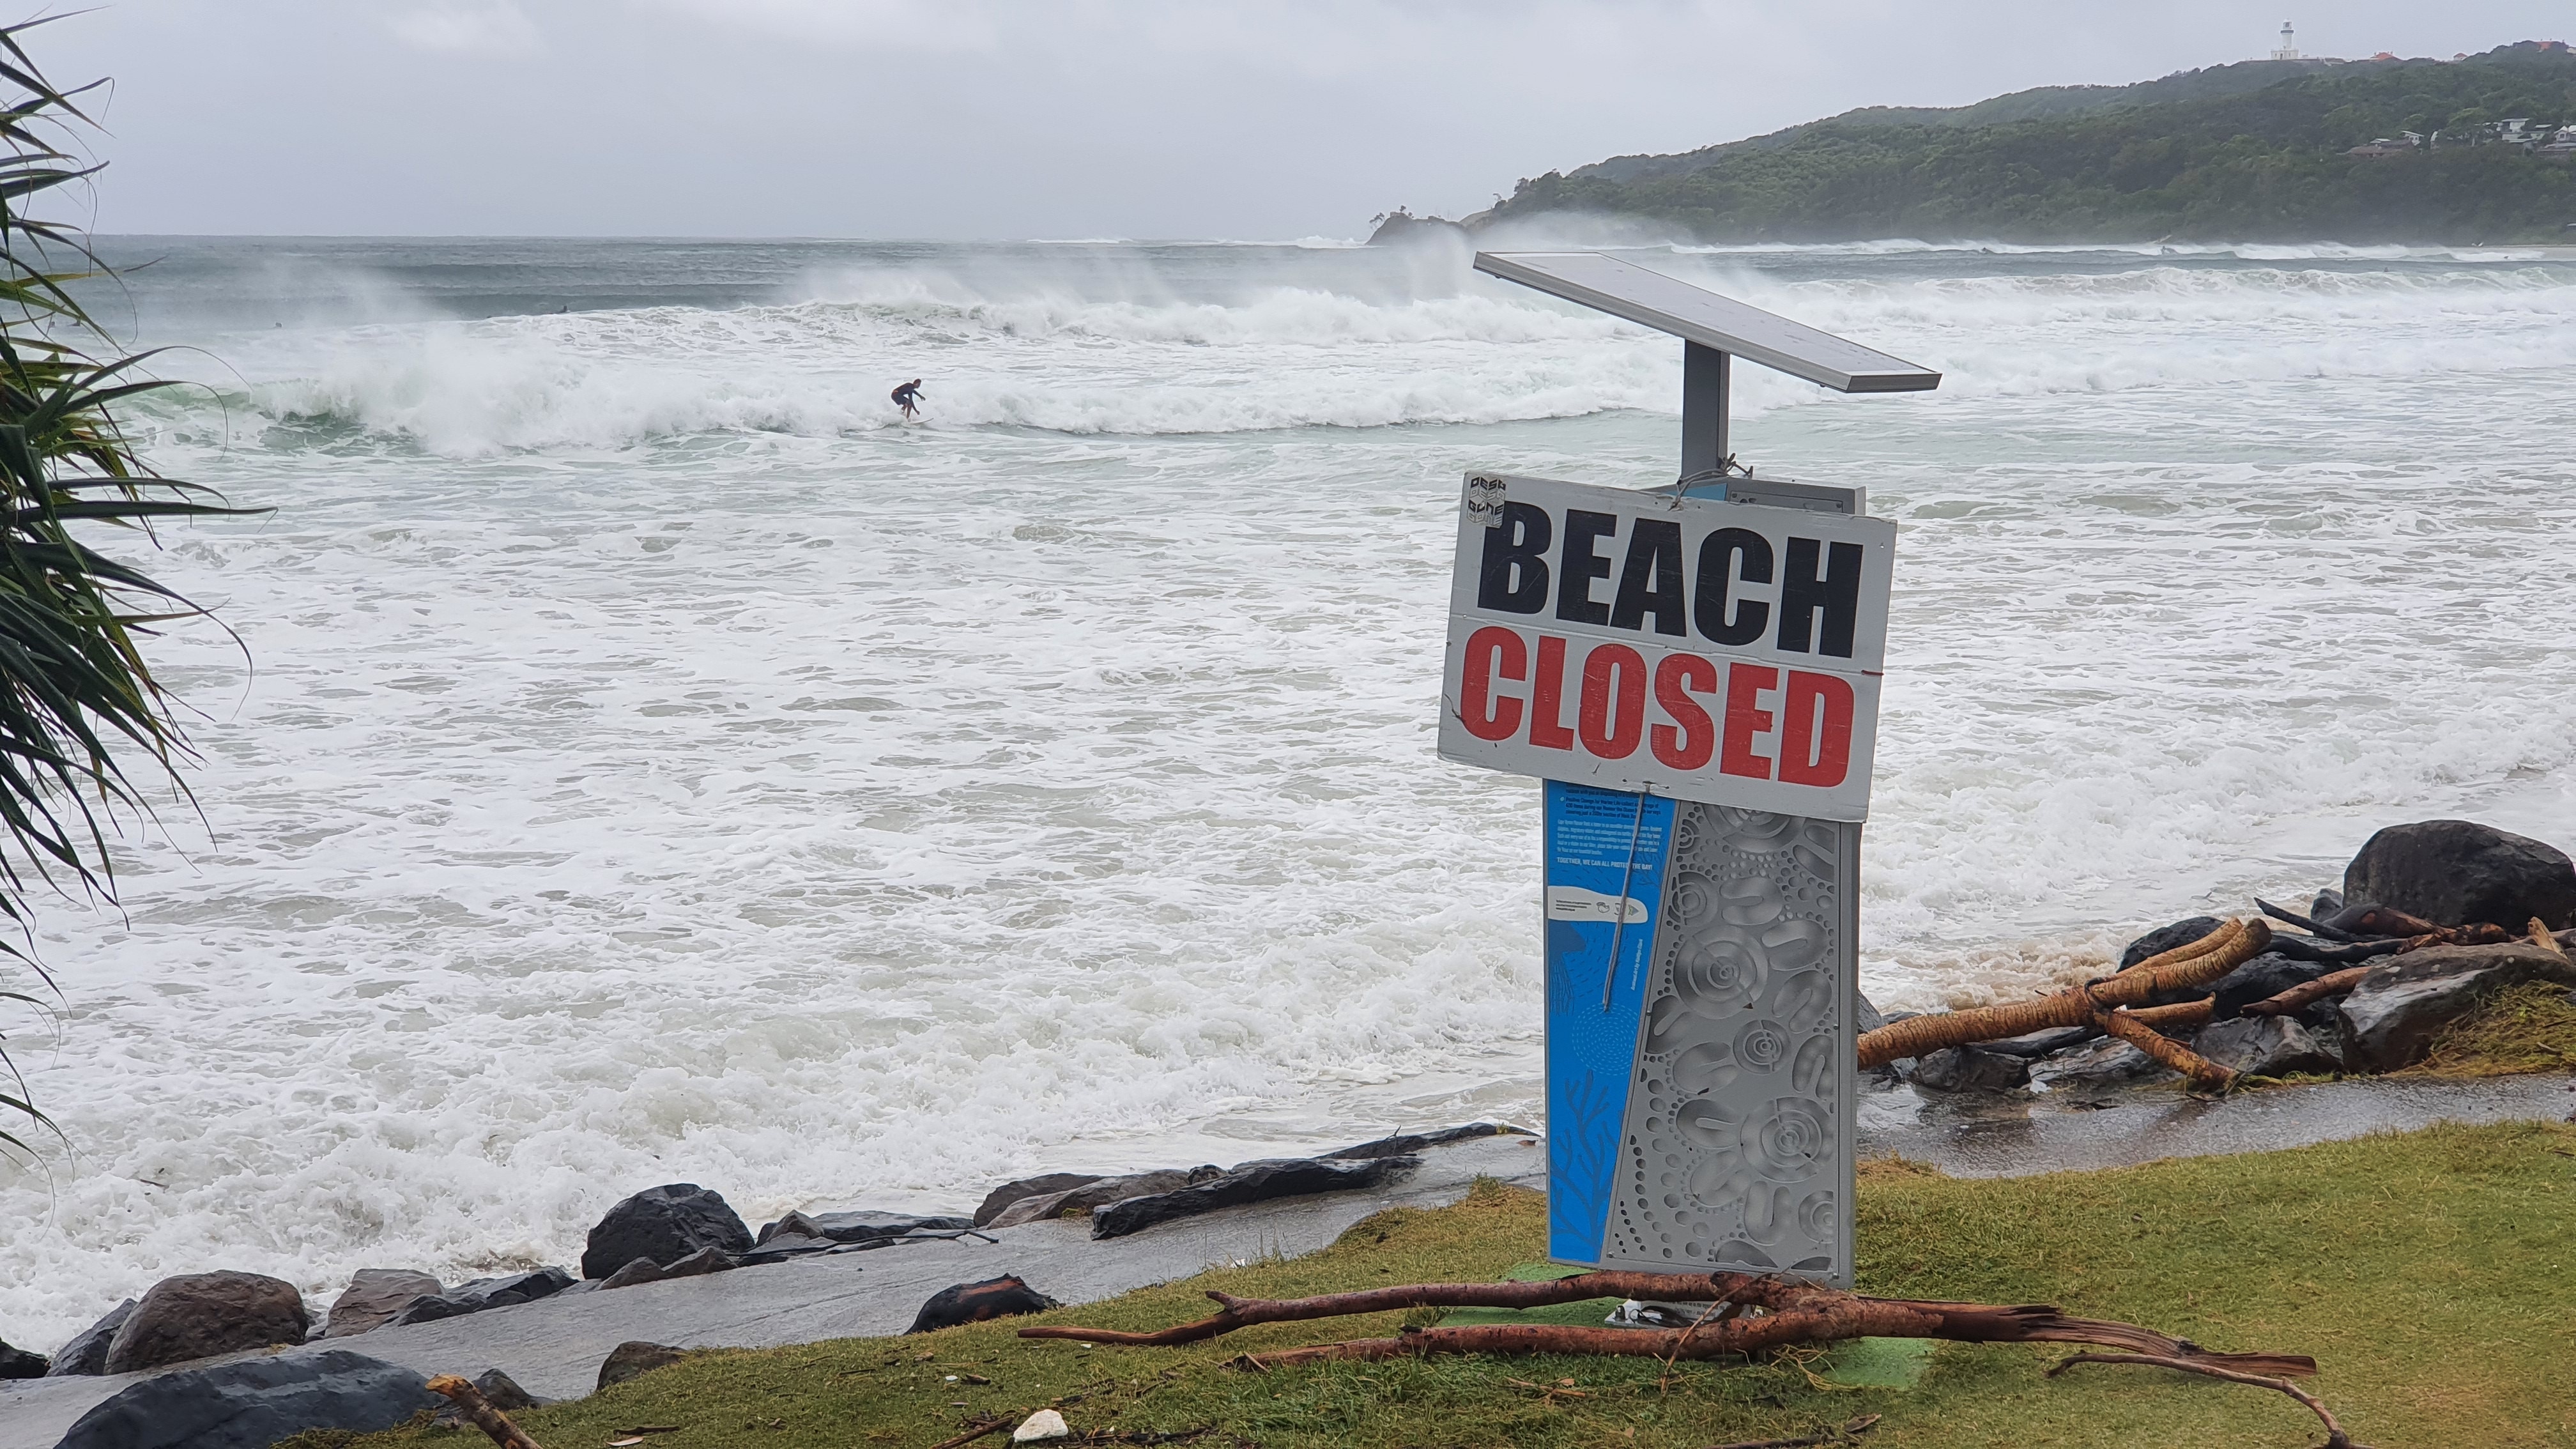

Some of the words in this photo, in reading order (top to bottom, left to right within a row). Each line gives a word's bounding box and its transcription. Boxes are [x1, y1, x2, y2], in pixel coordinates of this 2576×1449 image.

[1477, 501, 1864, 659] BEACH
[1460, 626, 1854, 787] CLOSED
[1557, 857, 1582, 866] TOGETHER,
